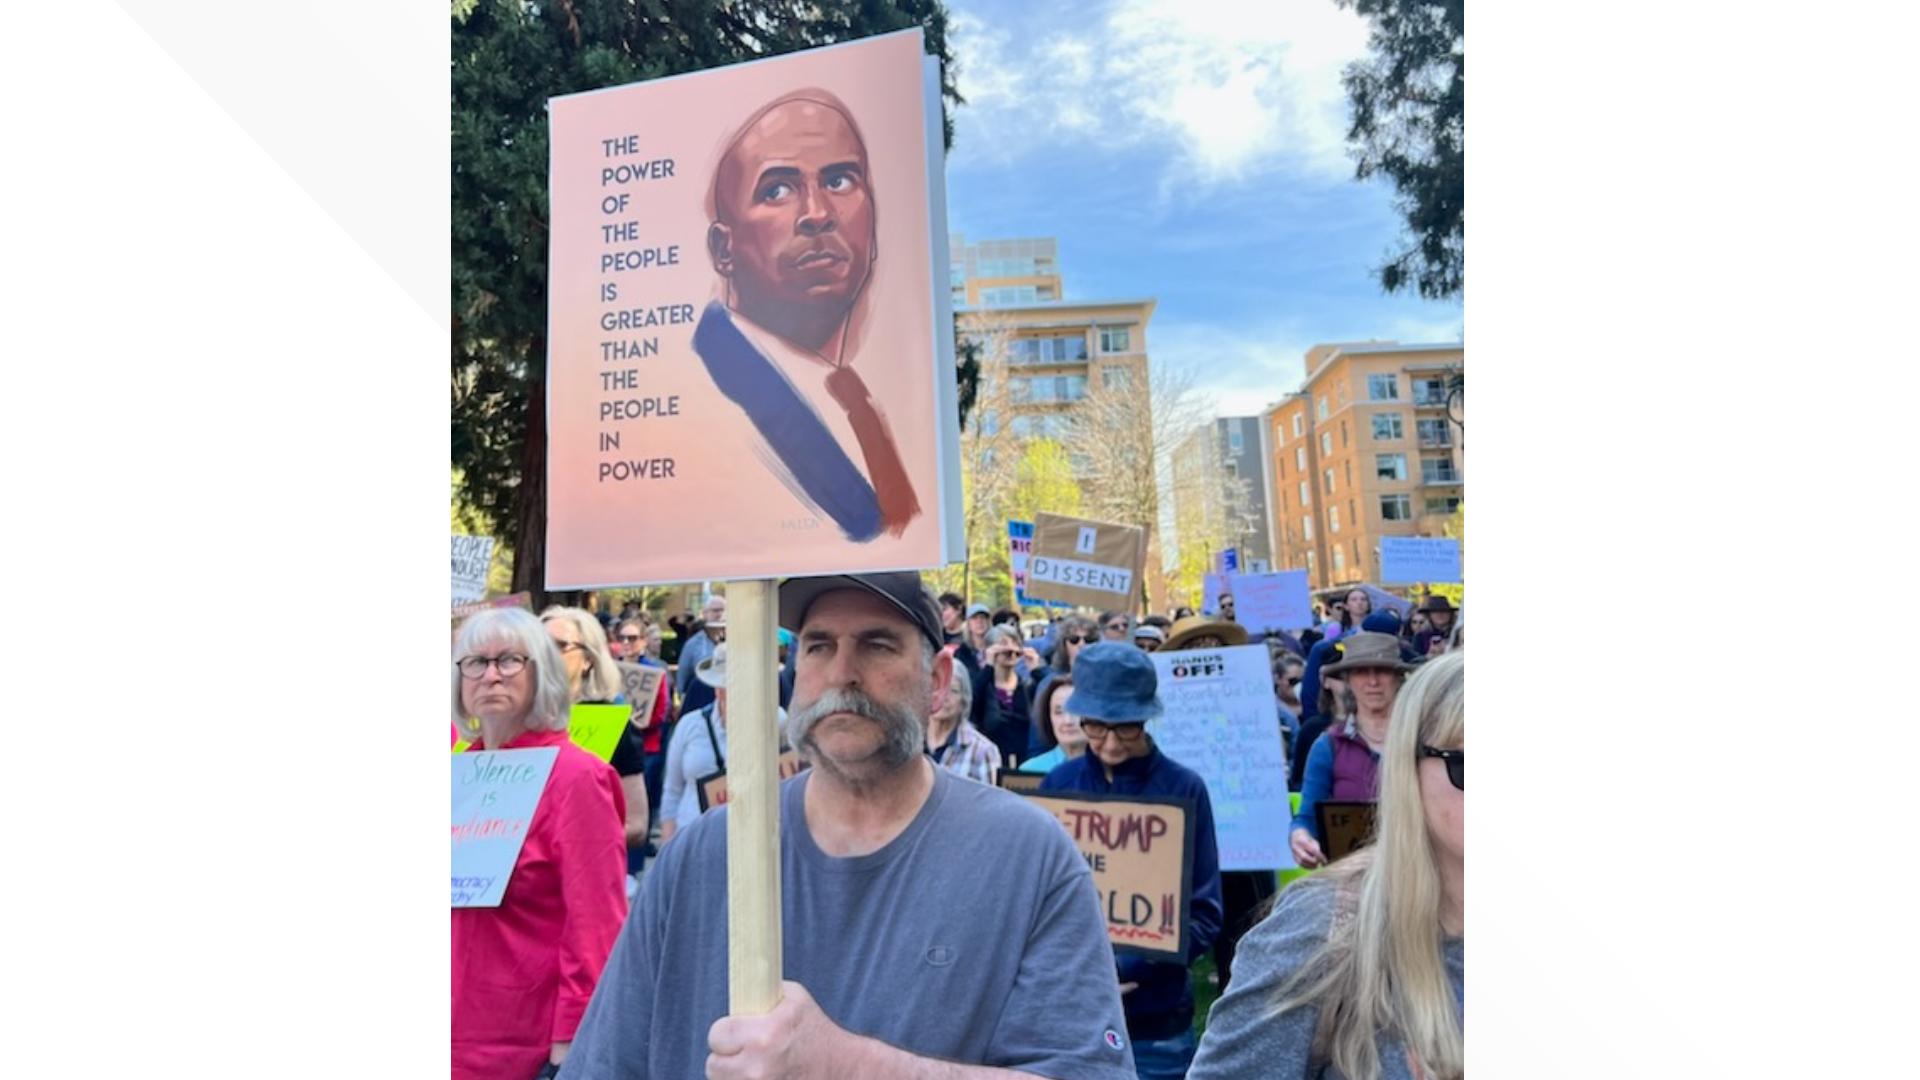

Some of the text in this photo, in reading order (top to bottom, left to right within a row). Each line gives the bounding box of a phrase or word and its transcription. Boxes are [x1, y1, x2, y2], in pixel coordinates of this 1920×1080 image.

[602, 135, 639, 157] THE
[602, 159, 675, 186] POWER
[602, 194, 630, 214] OF
[602, 221, 639, 244] THE
[601, 246, 679, 273] PEOPLE
[601, 283, 617, 302] IS
[600, 304, 694, 331] GREATER
[601, 337, 658, 361] THAN
[600, 369, 638, 391] THE
[600, 396, 680, 421] PEOPLE
[599, 431, 620, 451] IN
[599, 458, 675, 482] POWER
[451, 537, 493, 560] EOPLE
[1033, 558, 1129, 591] DISSENT
[1171, 654, 1223, 665] HANDS
[1172, 664, 1225, 678] OFF!
[620, 668, 656, 692] GE
[462, 753, 537, 785] Silence
[1054, 808, 1168, 853] -TRUMP
